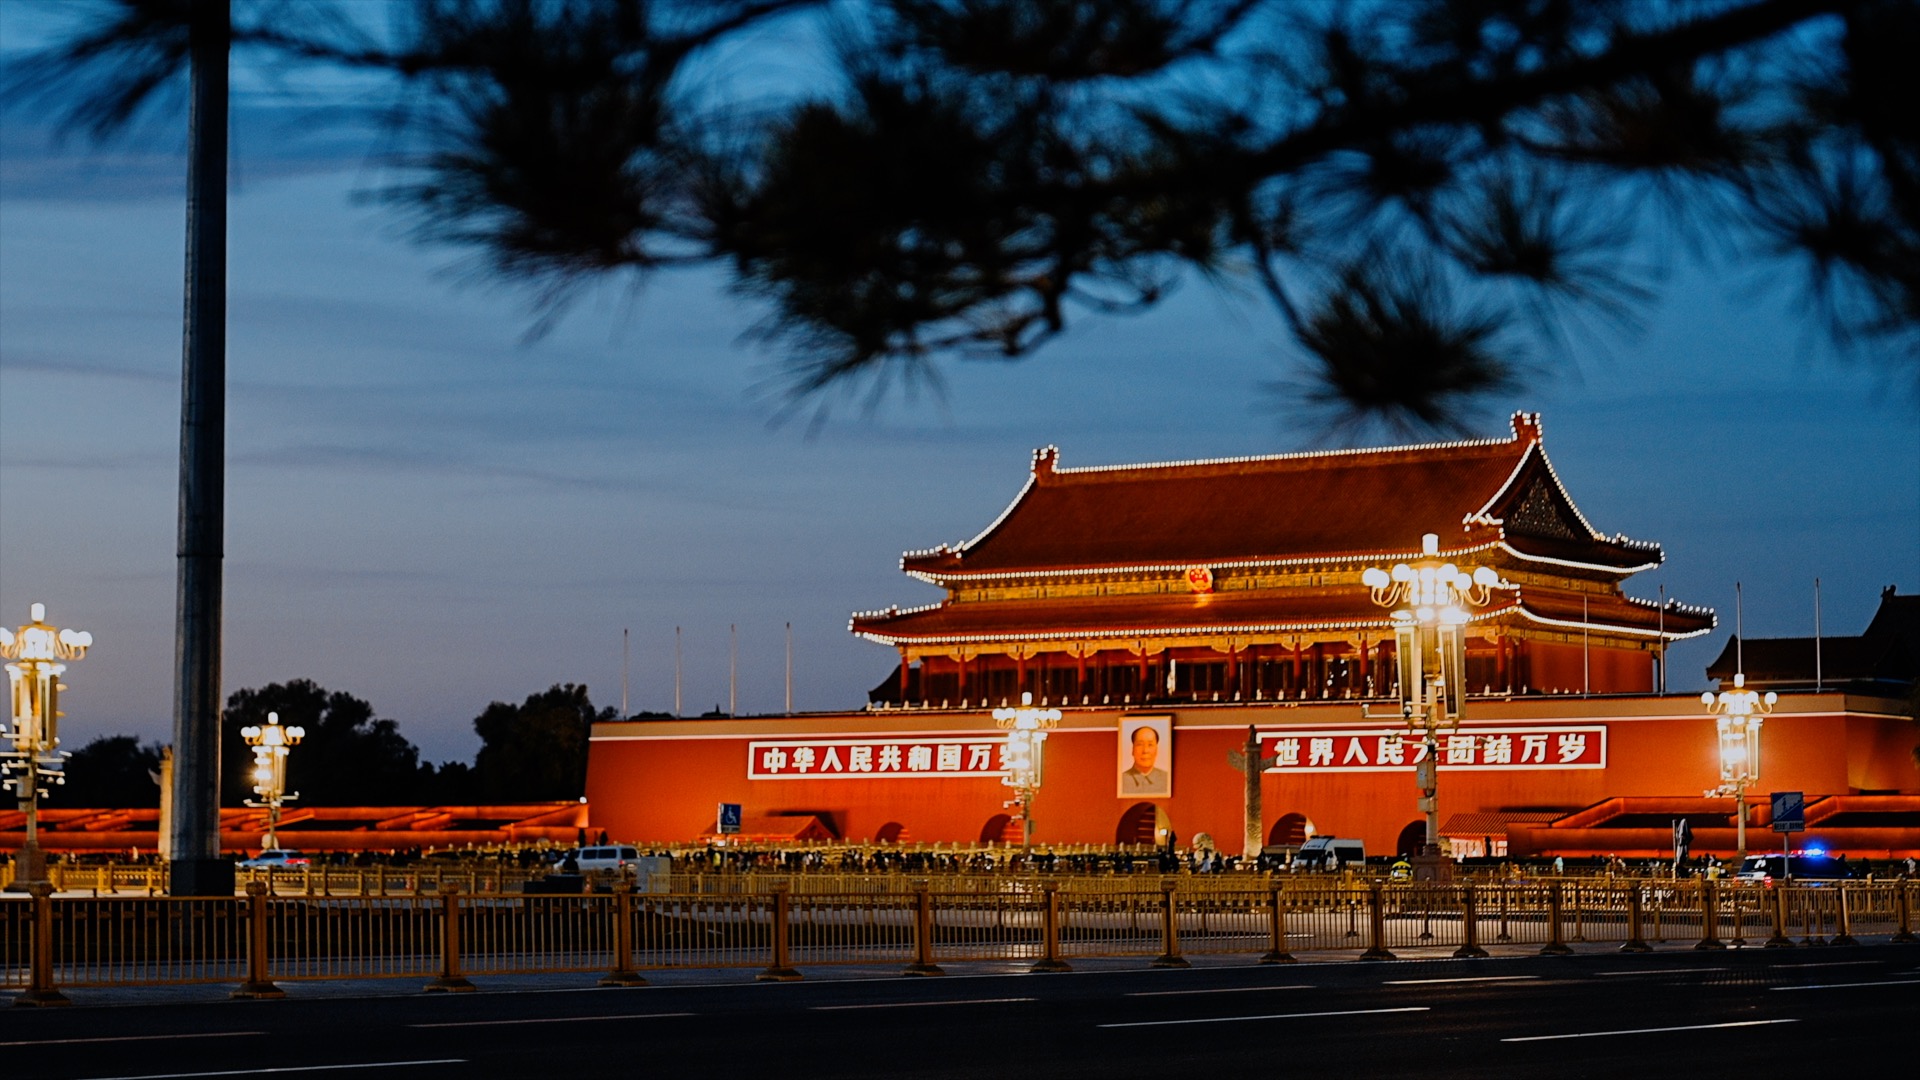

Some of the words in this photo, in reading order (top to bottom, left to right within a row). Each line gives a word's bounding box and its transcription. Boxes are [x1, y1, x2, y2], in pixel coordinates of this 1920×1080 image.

[1274, 733, 1586, 765] 世界人民大团结万岁
